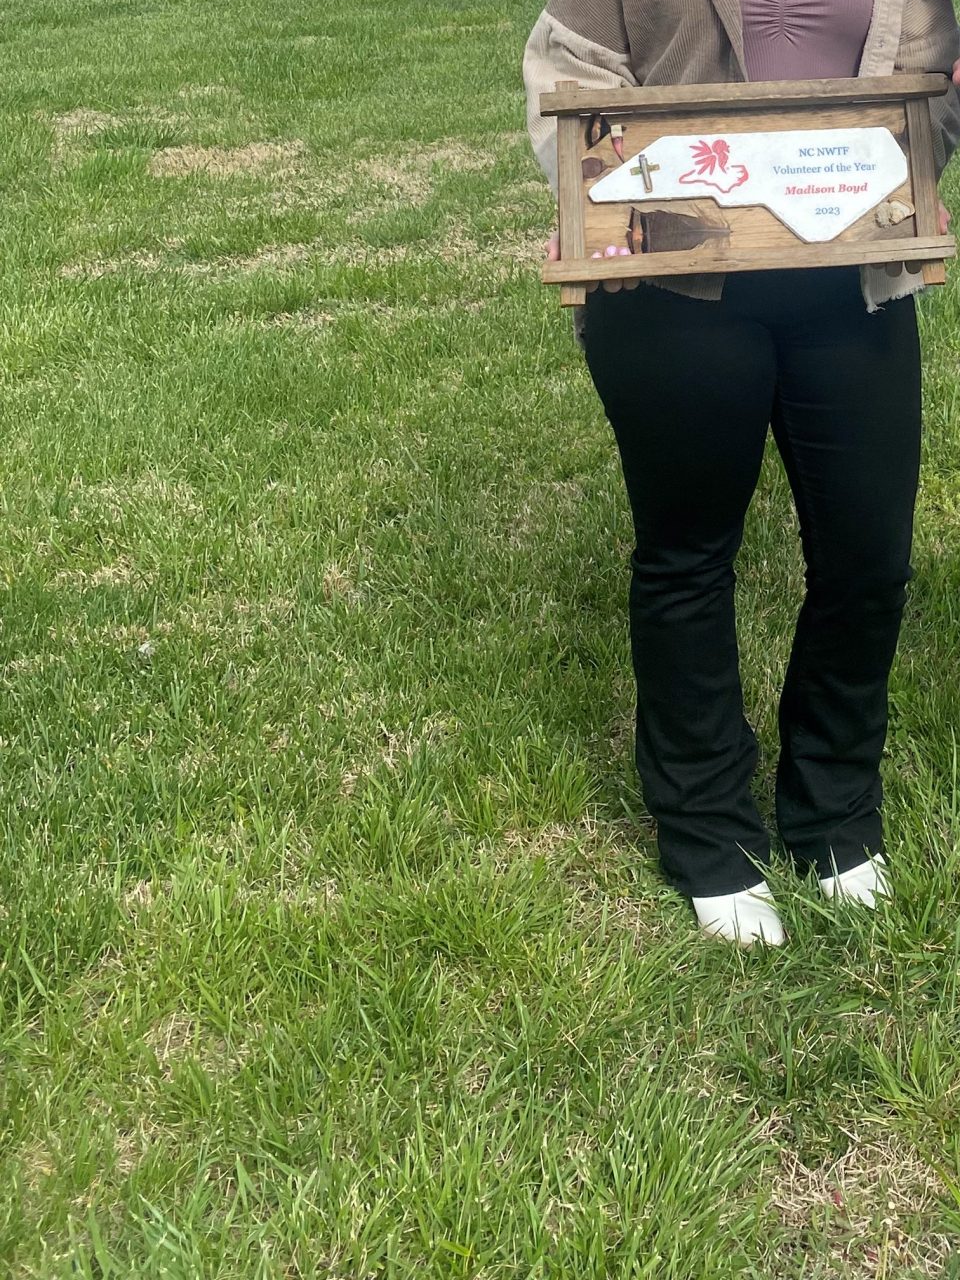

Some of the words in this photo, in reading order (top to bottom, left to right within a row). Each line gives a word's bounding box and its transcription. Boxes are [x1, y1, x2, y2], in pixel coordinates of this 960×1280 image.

[799, 148, 815, 157] NC
[817, 146, 849, 156] NWTF
[773, 165, 821, 175] Volunteer
[823, 163, 835, 173] of
[836, 163, 852, 173] the
[853, 162, 876, 171] Year
[785, 185, 835, 195] Madison
[838, 182, 868, 194] Boyd
[815, 206, 841, 216] 2023
